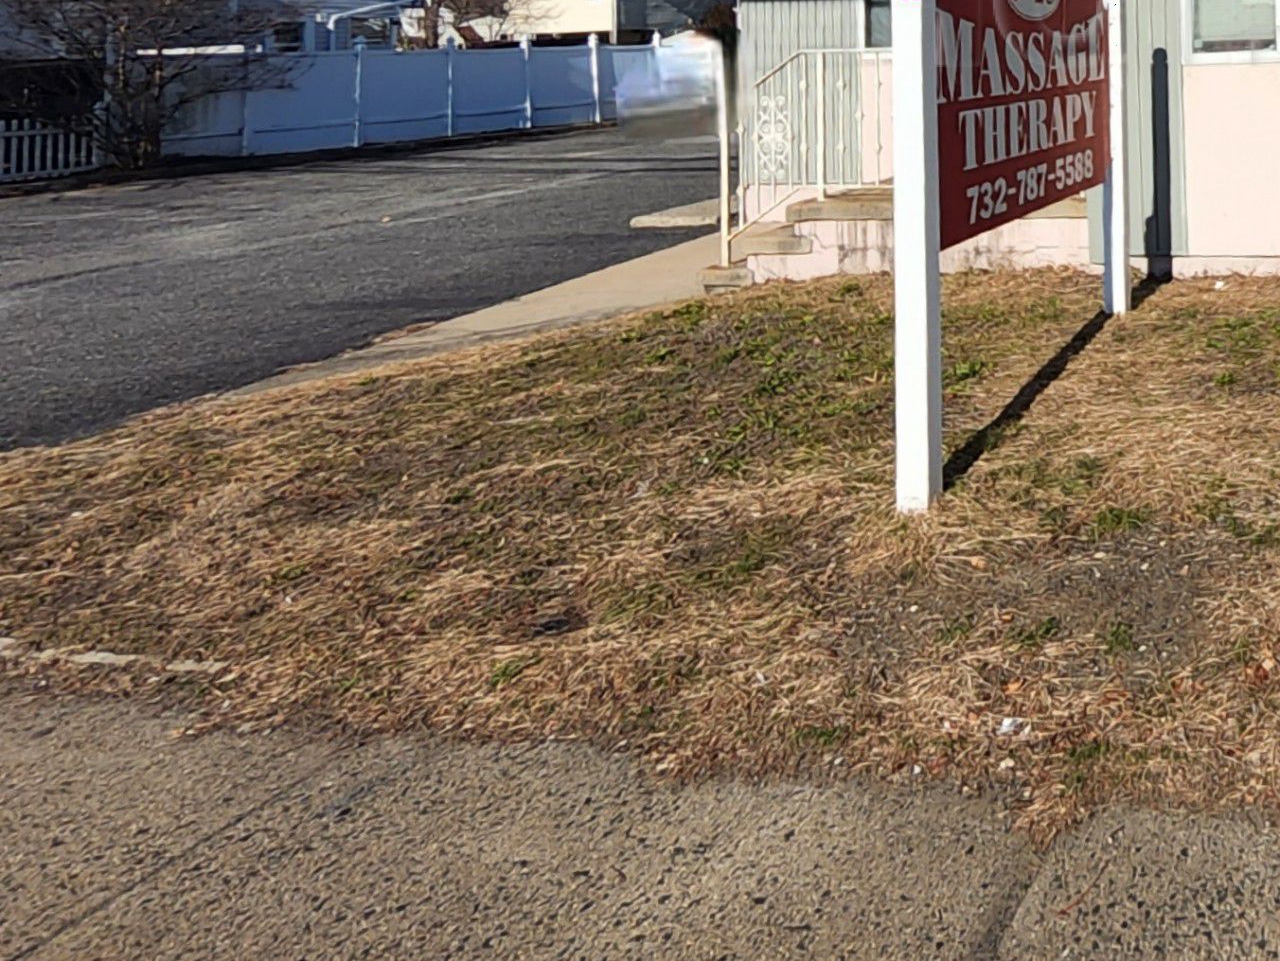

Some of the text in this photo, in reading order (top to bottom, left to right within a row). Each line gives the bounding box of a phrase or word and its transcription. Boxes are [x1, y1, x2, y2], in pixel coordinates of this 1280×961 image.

[937, 9, 1105, 105] MASSAGE
[958, 91, 1097, 171] THERAPY
[966, 149, 1094, 225] 732-787-5588
